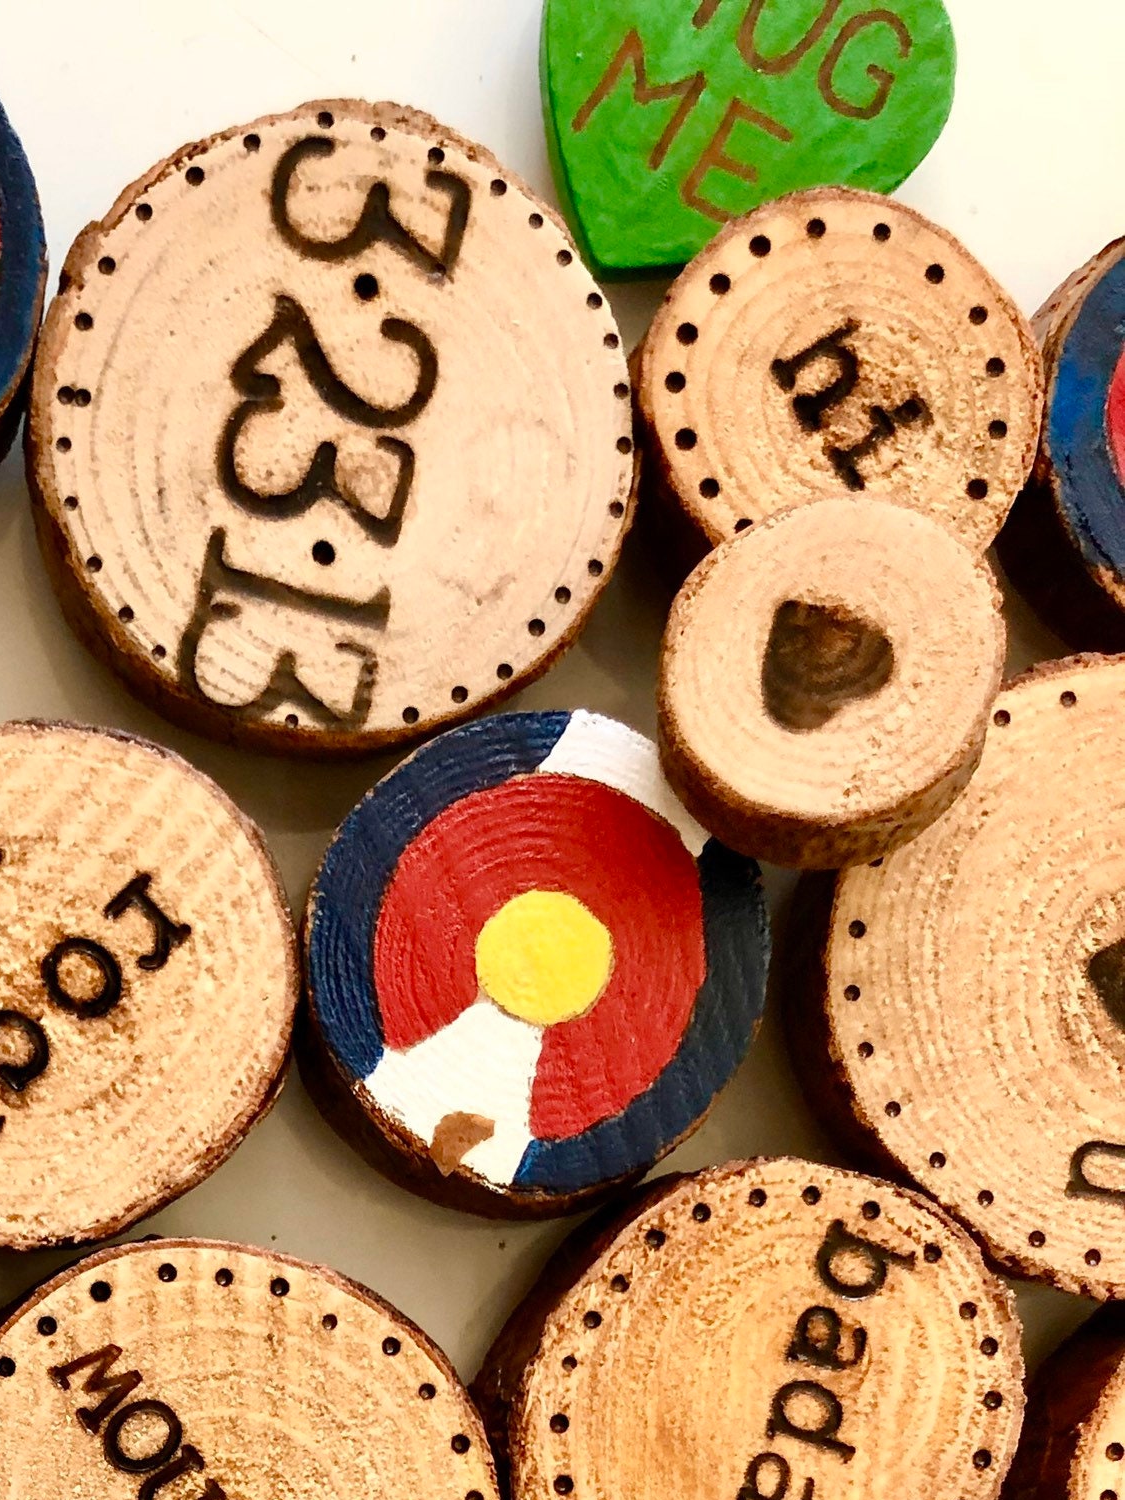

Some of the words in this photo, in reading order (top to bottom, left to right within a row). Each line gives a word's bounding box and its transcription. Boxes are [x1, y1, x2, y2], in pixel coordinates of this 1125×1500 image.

[572, 28, 793, 224] ME
[692, 0, 912, 120] UG
[770, 317, 934, 492] hi
